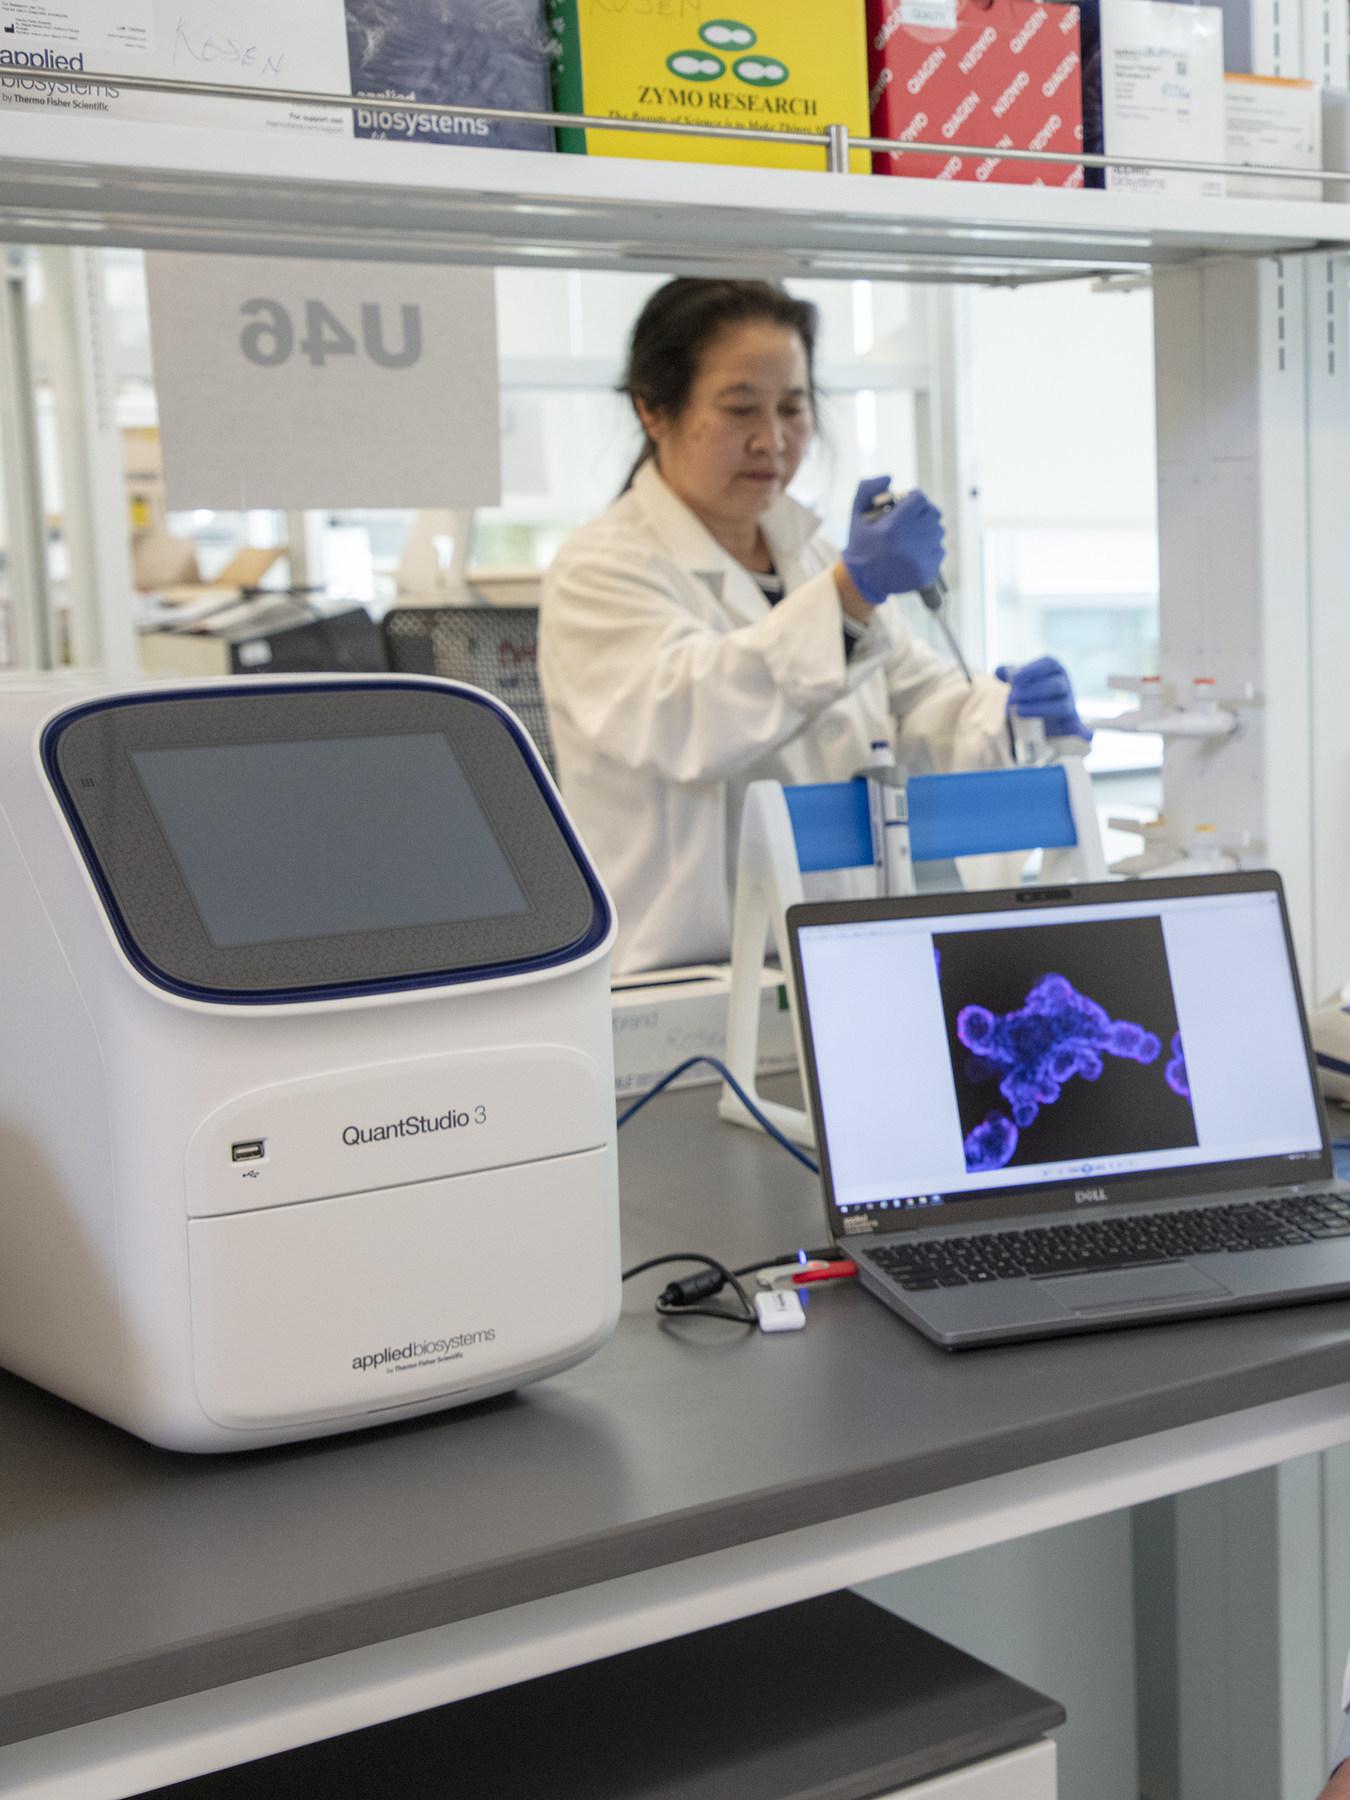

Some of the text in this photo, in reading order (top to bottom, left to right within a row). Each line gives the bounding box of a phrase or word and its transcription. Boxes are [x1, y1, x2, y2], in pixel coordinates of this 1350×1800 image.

[0, 48, 84, 71] applied
[907, 46, 946, 94] QIAGEN
[14, 94, 45, 105] Thermo
[46, 95, 71, 107] Fisher
[72, 100, 109, 112] Scientific
[637, 85, 818, 116] ZYMO RESEARCH
[357, 109, 490, 137] biosystems
[342, 1104, 487, 1146] QuantStudio 3
[1074, 1187, 1107, 1204] DELL
